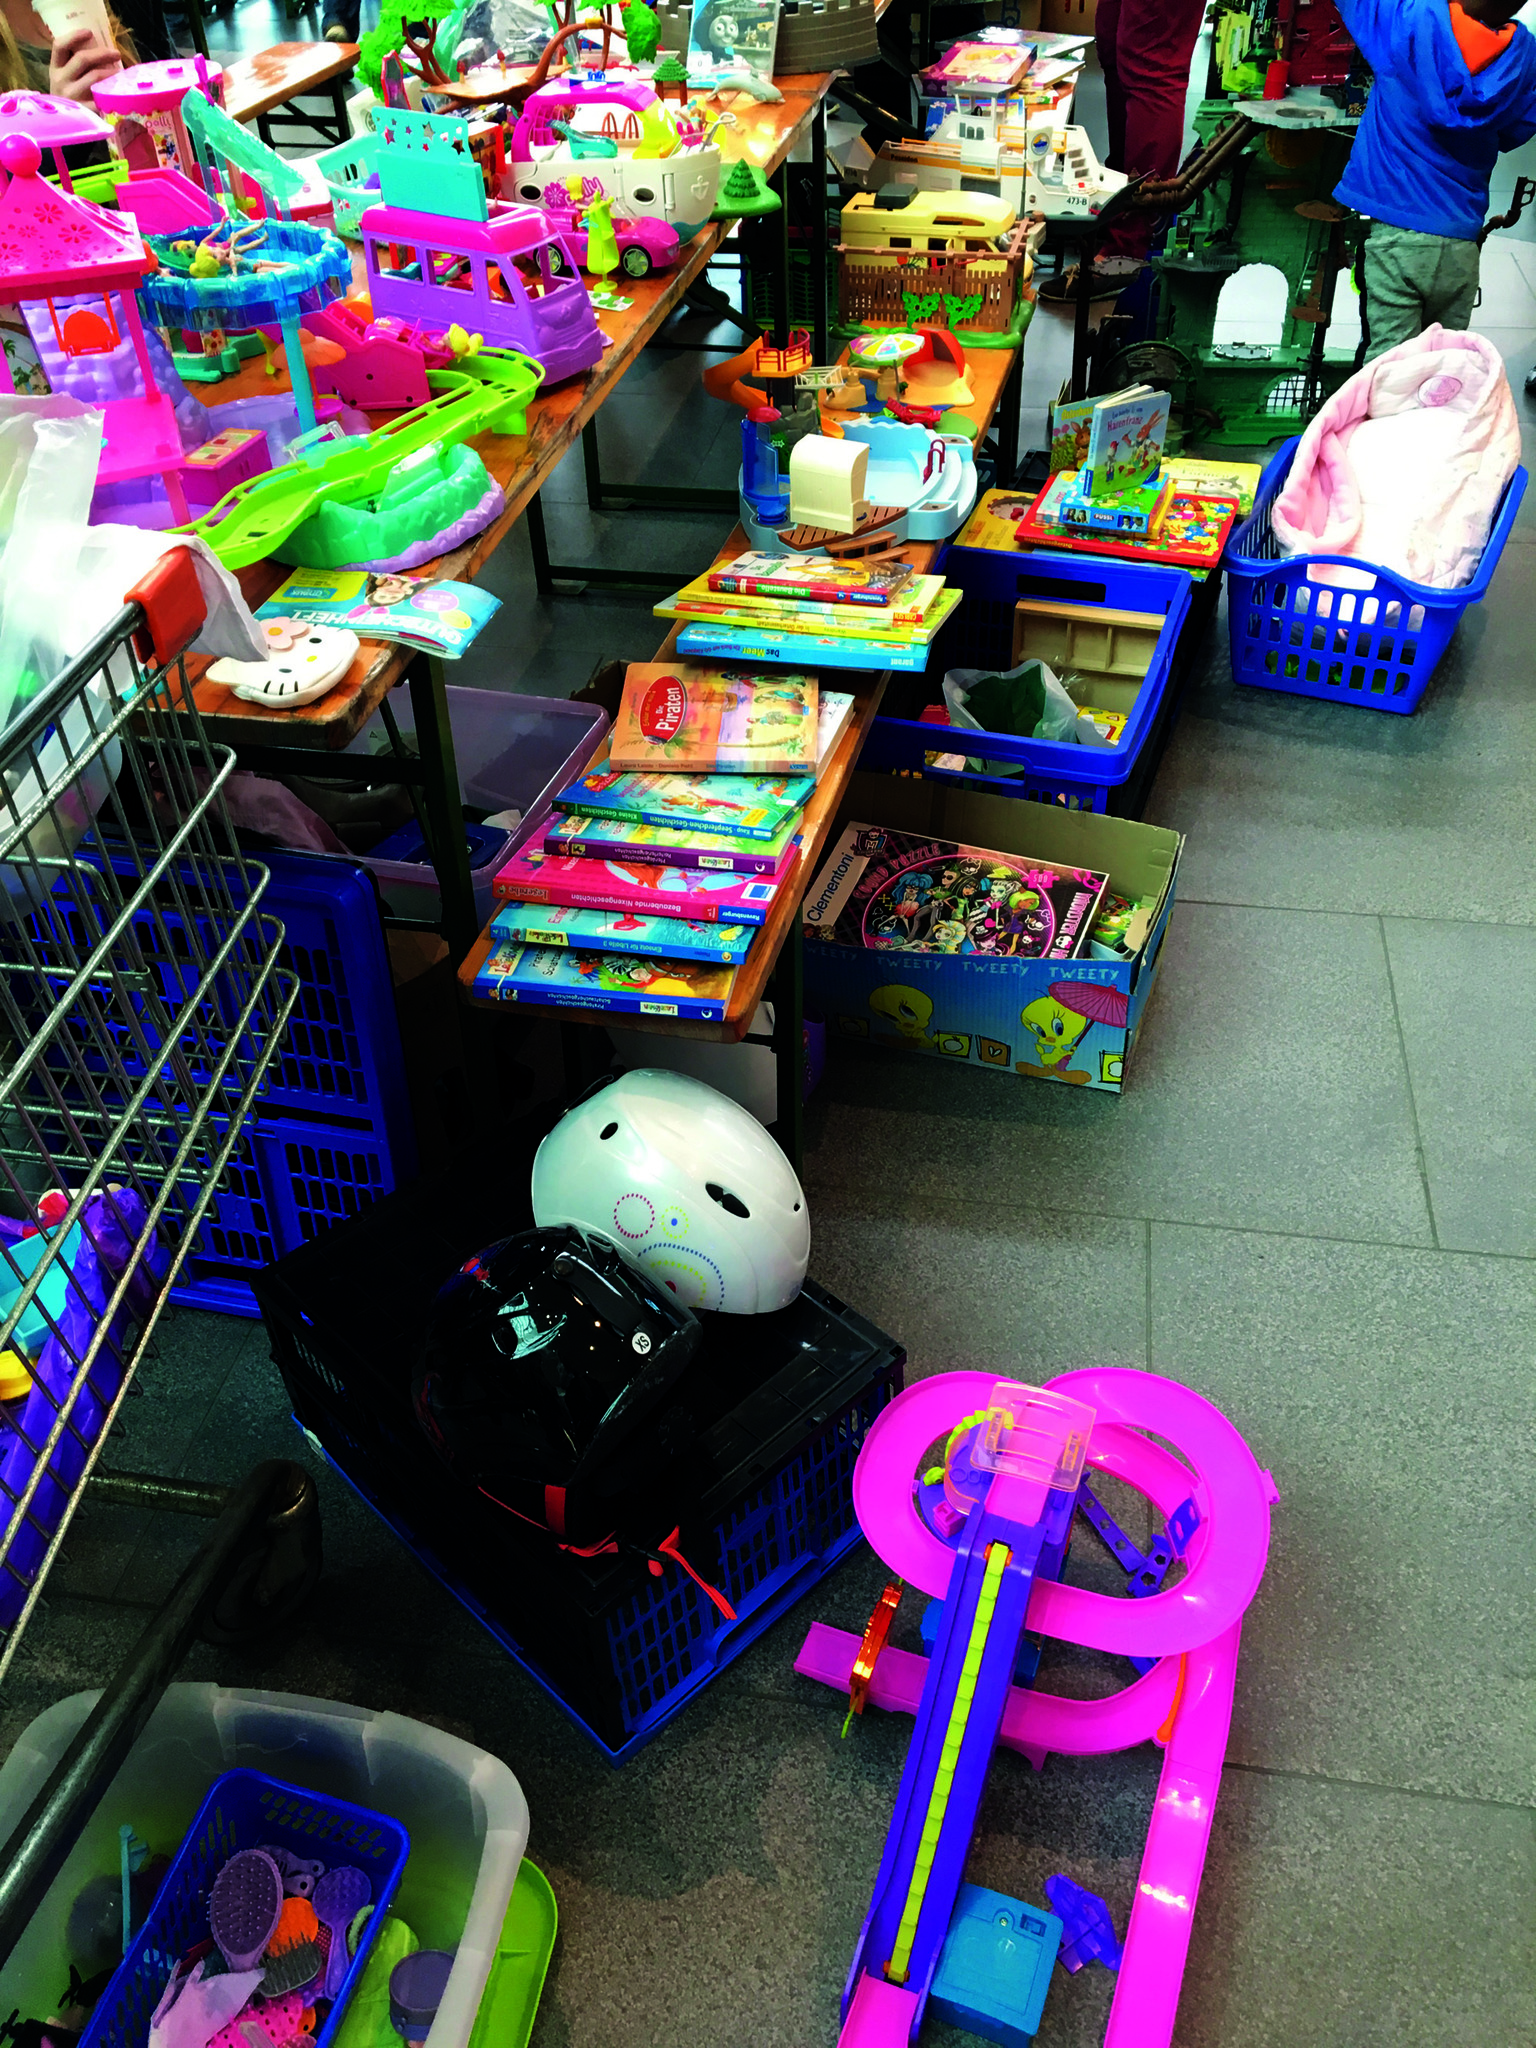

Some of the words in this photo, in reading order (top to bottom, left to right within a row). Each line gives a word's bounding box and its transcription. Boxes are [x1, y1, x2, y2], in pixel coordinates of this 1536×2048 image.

[890, 153, 919, 163] Poseidon
[1066, 196, 1088, 206] 473-B
[761, 585, 792, 594] Baustelle
[794, 588, 805, 596] Die
[894, 612, 917, 621] CARLSEN
[742, 646, 765, 658] Meer
[766, 648, 780, 658] Das
[890, 658, 914, 667] garant
[655, 687, 680, 731] Piraten
[655, 705, 664, 714] Die
[580, 807, 618, 817] Geschichten
[619, 811, 637, 820] Kleine
[649, 816, 732, 833] Seepferdchen-Geschichten
[736, 826, 750, 836] Kaup
[852, 866, 888, 899] ROUND
[889, 843, 940, 870] PUZZLE
[1033, 874, 1048, 883] 500
[806, 852, 854, 922] Clementoni
[508, 886, 548, 900] Leserabe
[570, 893, 633, 908] Nixengeschichten
[634, 900, 682, 912] Bezaubernde
[721, 910, 760, 921] Ravensburger
[1059, 892, 1093, 936] MONSTER
[607, 941, 629, 950] Libelle
[639, 944, 662, 953] Einsatz
[877, 956, 942, 971] TWEETY
[963, 961, 1030, 977] TWEETY
[1048, 967, 1119, 981] TWEETY
[635, 1335, 649, 1352] XS
